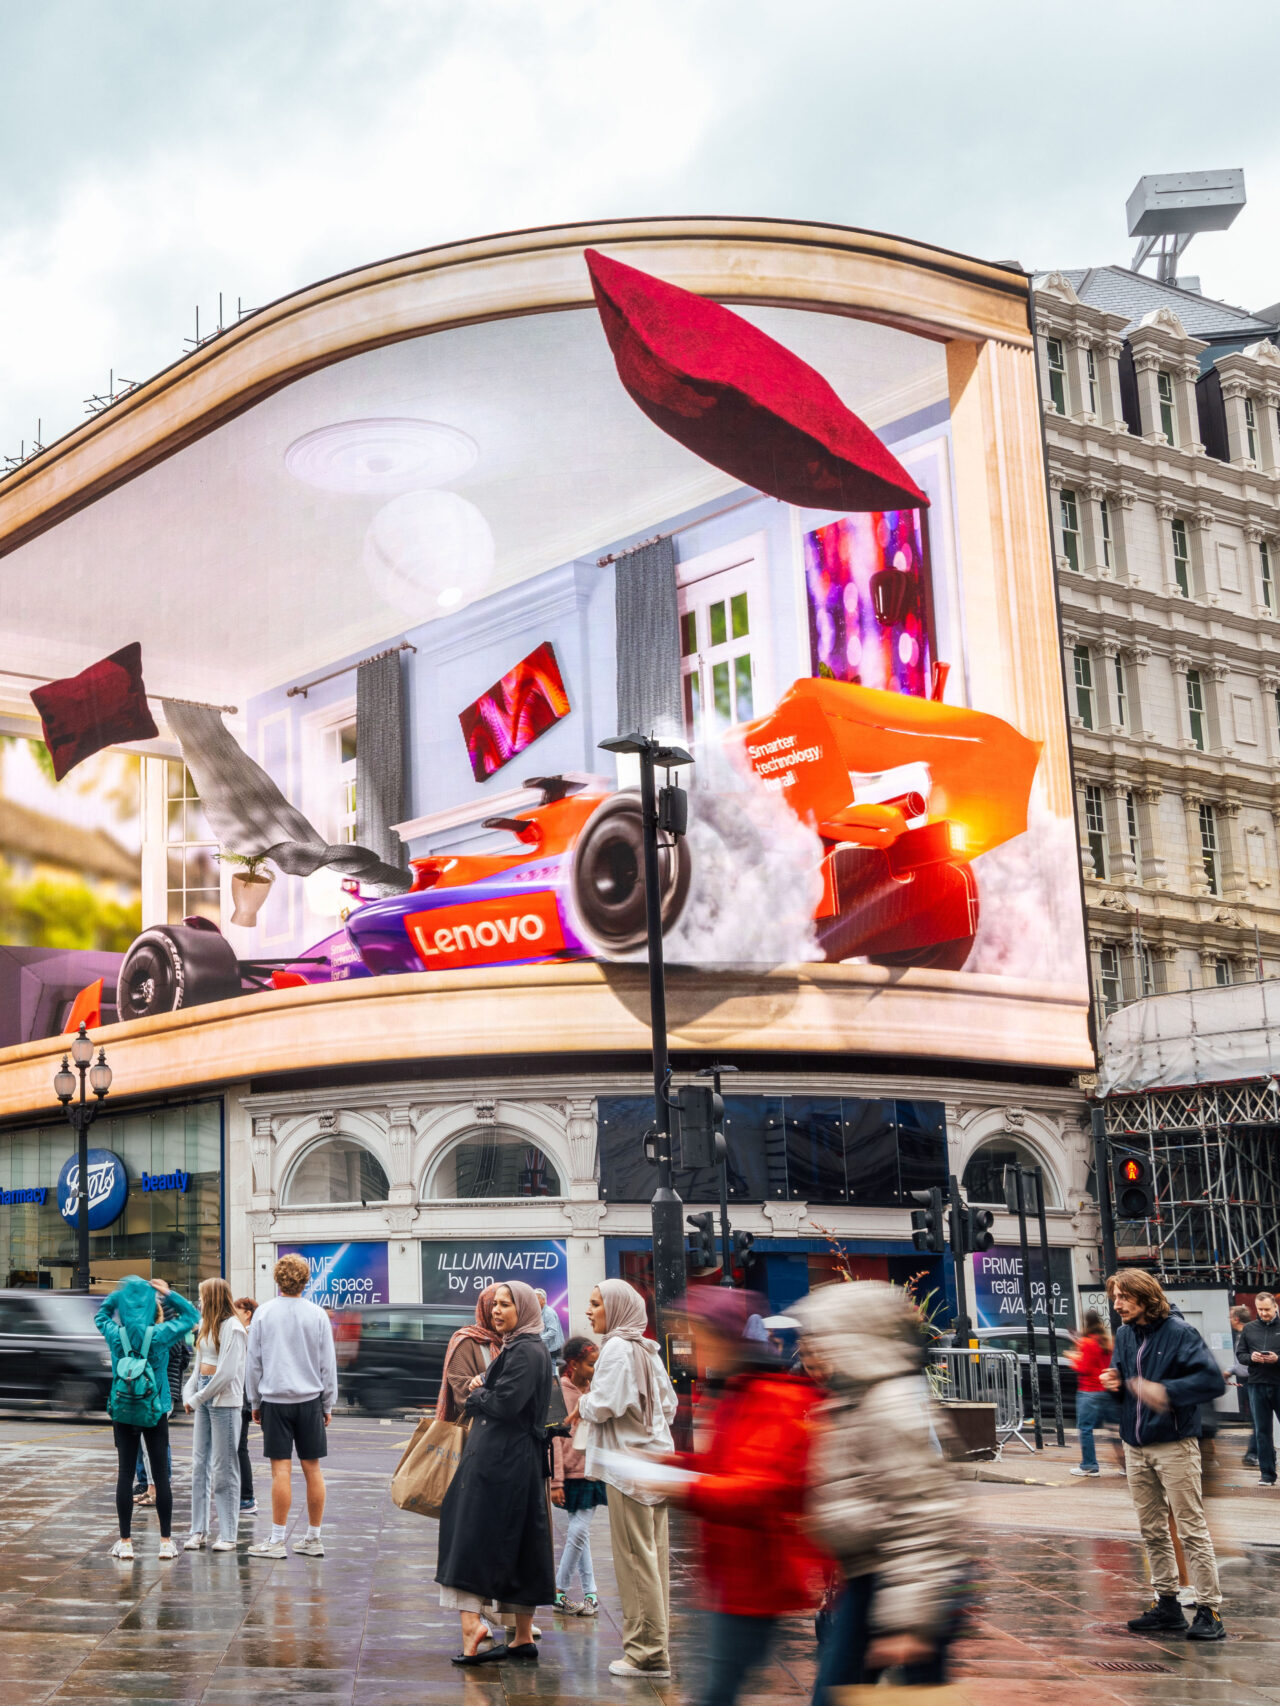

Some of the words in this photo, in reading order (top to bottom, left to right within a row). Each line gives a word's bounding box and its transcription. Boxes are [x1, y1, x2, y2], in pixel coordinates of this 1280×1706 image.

[748, 735, 796, 759] Smarter
[755, 745, 822, 775] technology
[780, 770, 797, 787] all
[413, 914, 546, 956] Lenovo
[141, 1169, 190, 1193] beauty
[438, 1252, 559, 1270] ILLUMINATED
[982, 1257, 1024, 1275] PRIME
[330, 1278, 373, 1294] space
[448, 1273, 469, 1293] by
[473, 1275, 495, 1289] an
[991, 1278, 1020, 1295] retail
